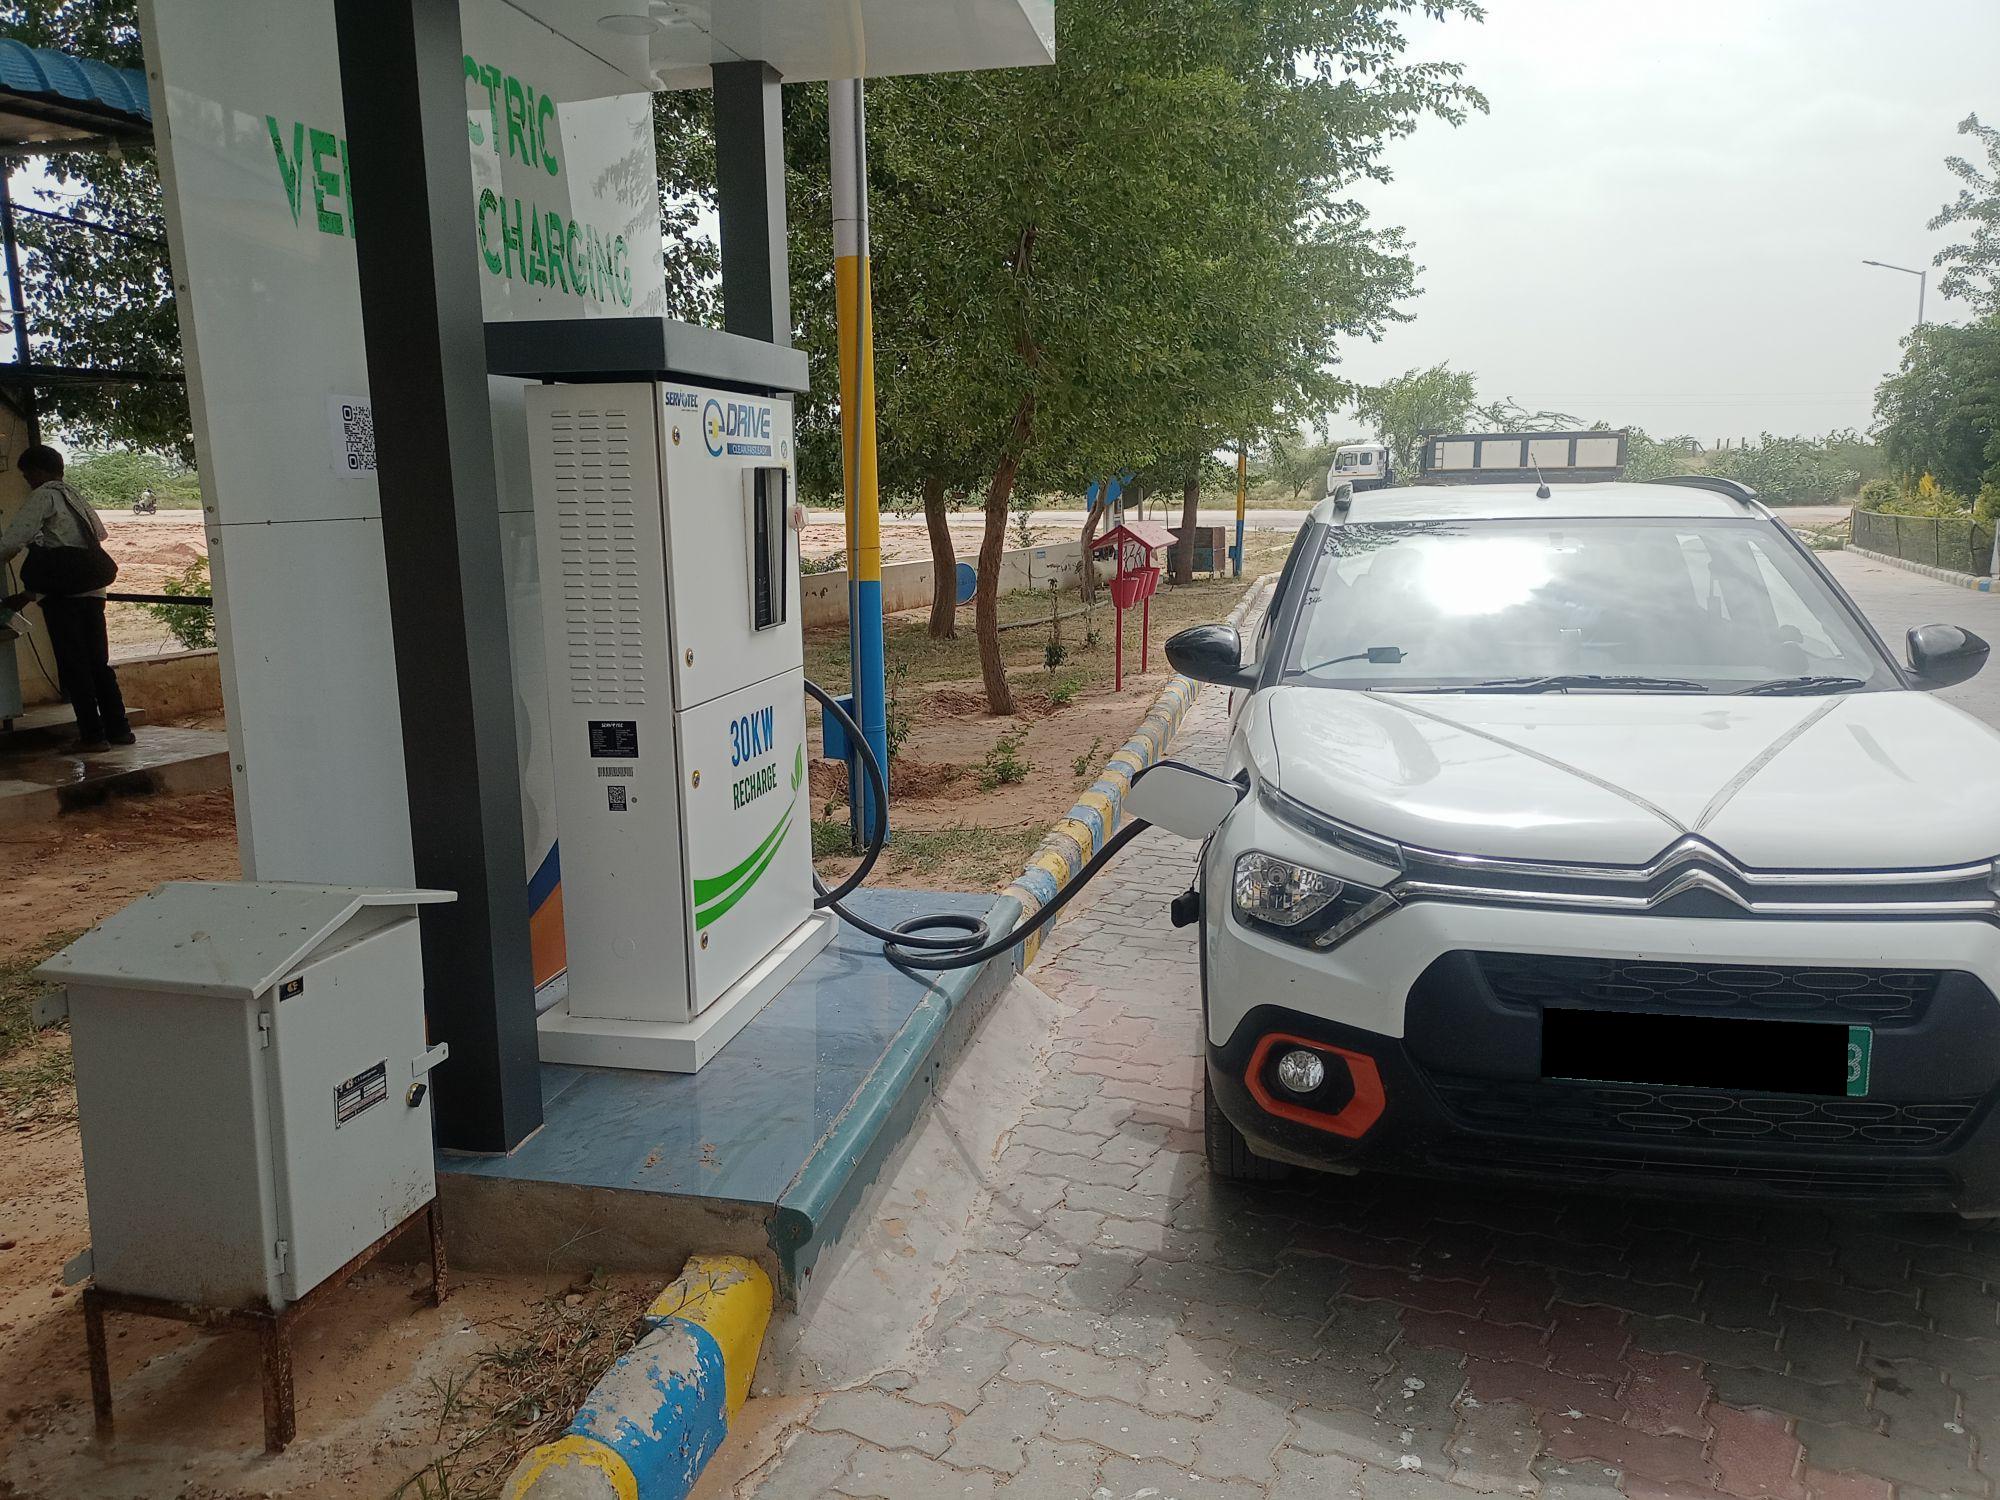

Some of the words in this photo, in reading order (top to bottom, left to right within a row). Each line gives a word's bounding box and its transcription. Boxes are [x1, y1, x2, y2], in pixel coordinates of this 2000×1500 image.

[478, 187, 633, 308] CHARGING
[726, 403, 771, 439] DRIVE
[730, 705, 773, 767] 30KW
[733, 763, 777, 810] RECHARGE
